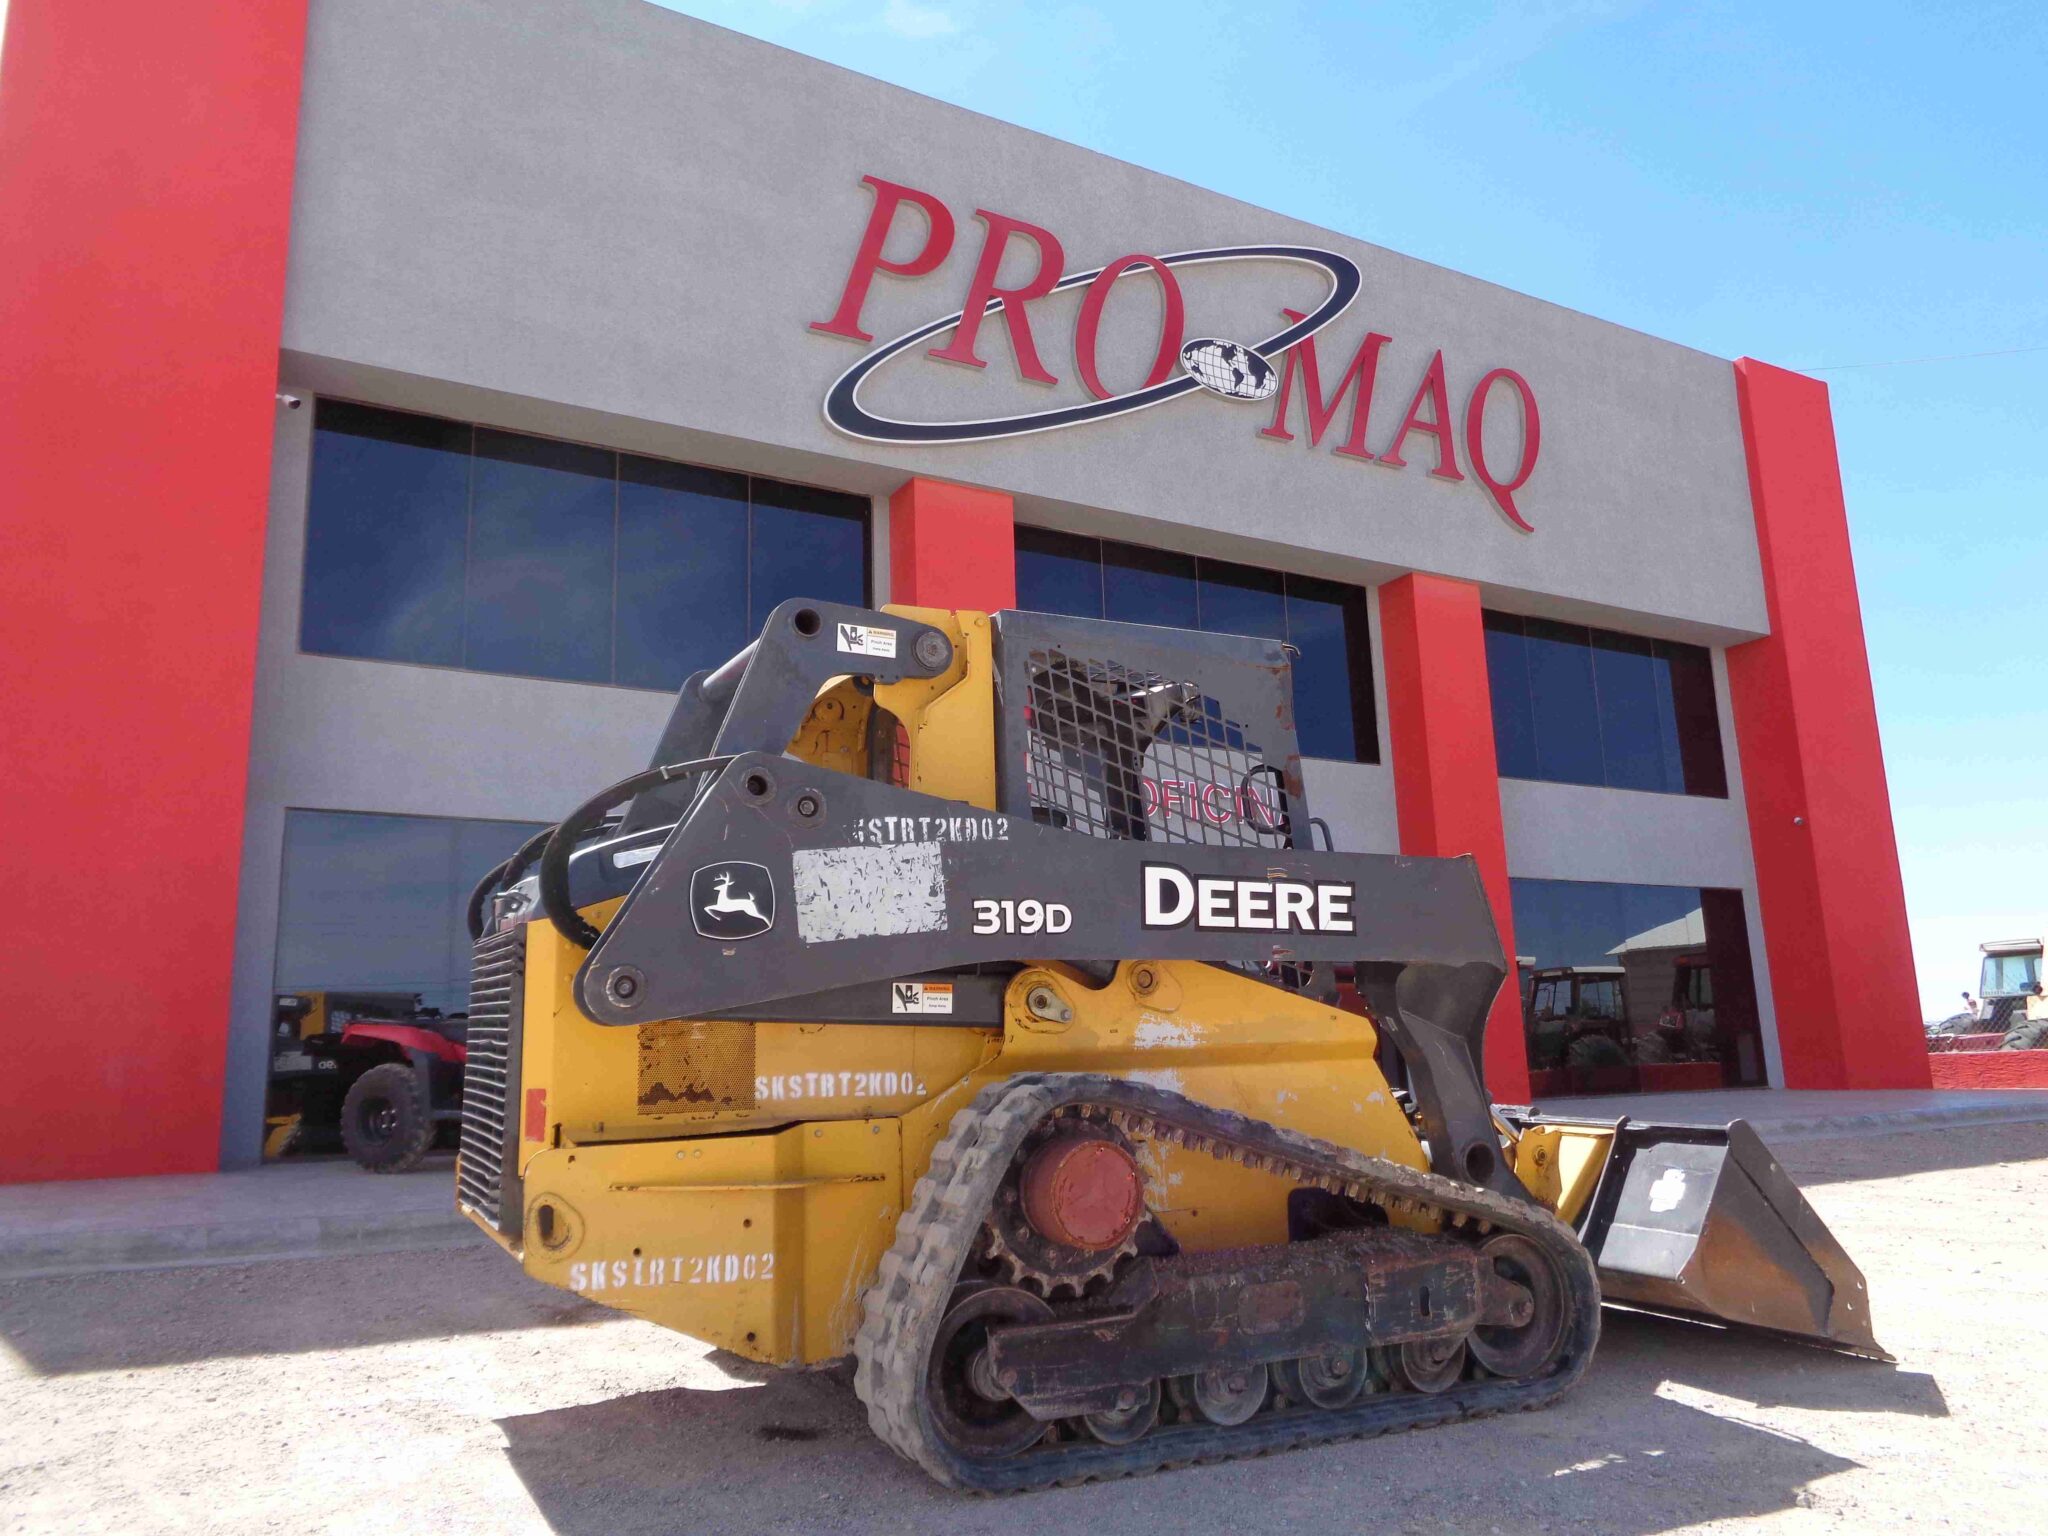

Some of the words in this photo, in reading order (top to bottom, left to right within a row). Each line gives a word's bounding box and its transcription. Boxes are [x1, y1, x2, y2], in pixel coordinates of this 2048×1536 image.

[809, 174, 1185, 400] PRO
[1257, 307, 1541, 533] MAQ
[1142, 777, 1285, 827] OFICIN
[972, 899, 1073, 934] 319D
[1143, 864, 1355, 934] DEERE
[569, 1252, 775, 1292] SKSTRT2KD02
